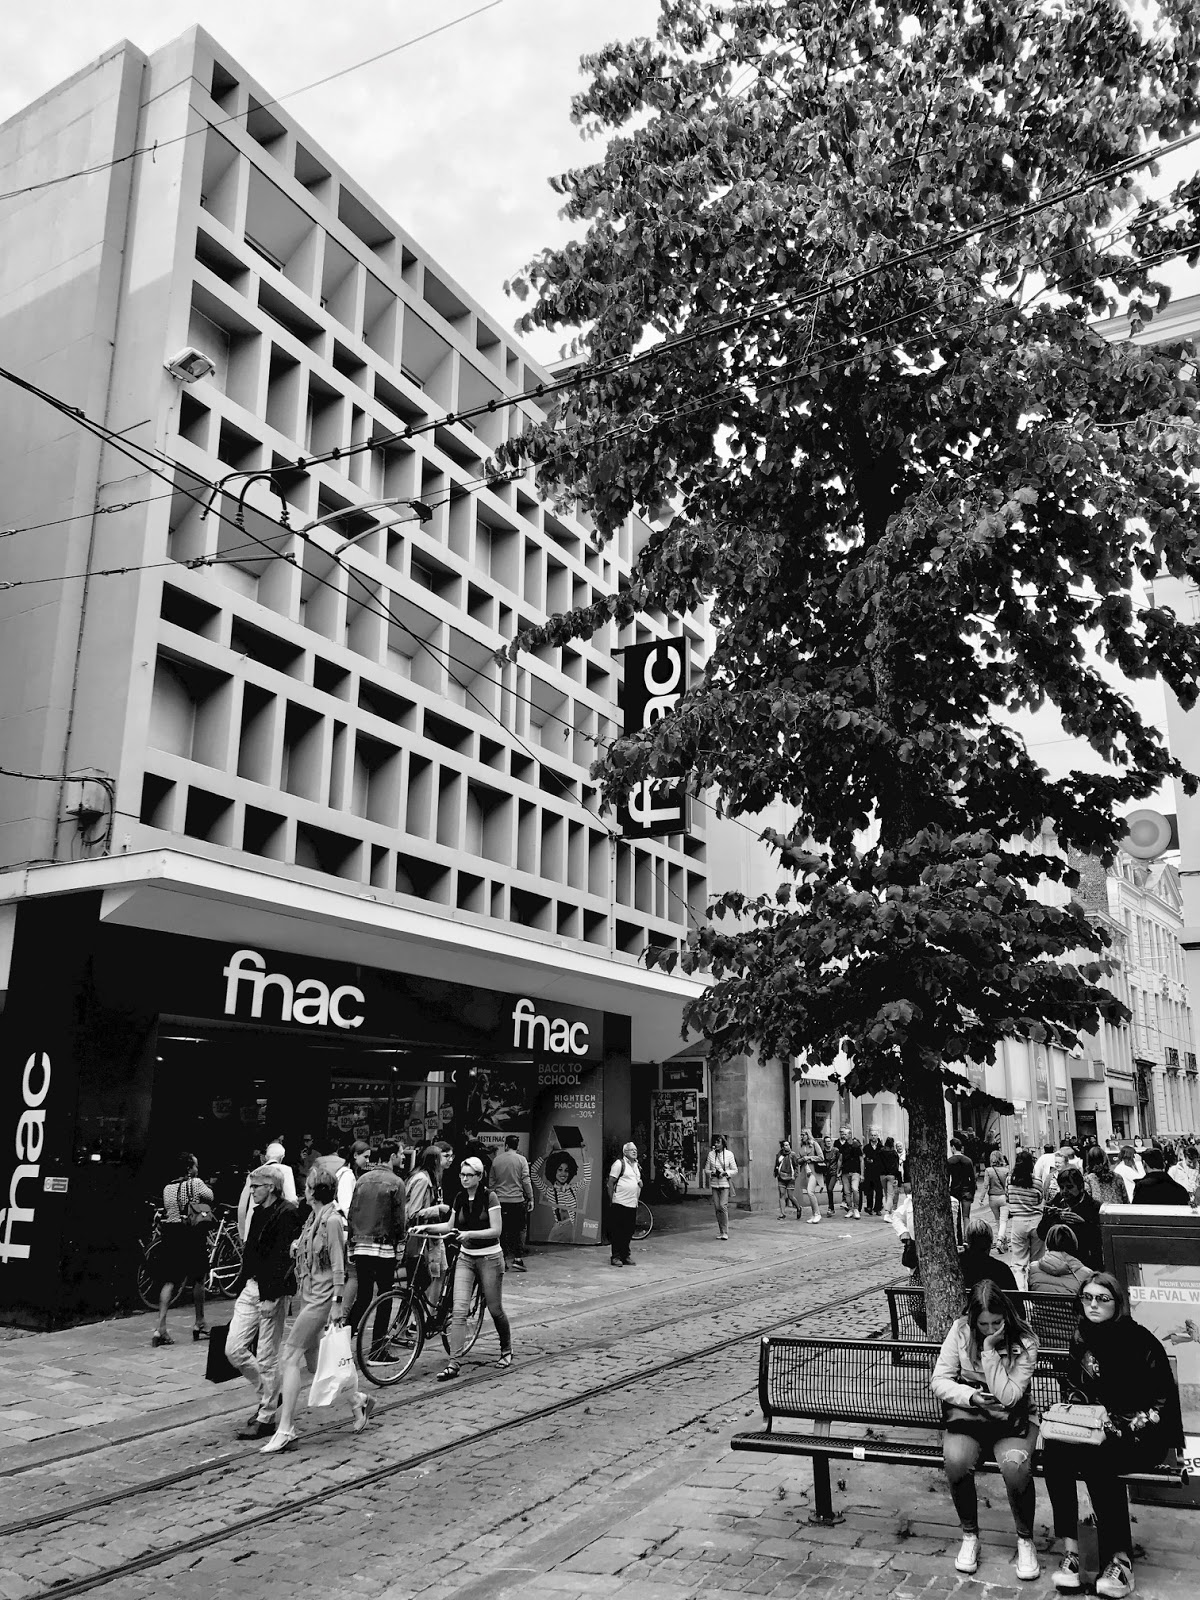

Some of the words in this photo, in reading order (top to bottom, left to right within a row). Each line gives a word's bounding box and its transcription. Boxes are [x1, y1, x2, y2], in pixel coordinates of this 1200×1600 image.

[223, 949, 365, 1029] fnac
[512, 998, 589, 1055] fnac
[538, 1063, 565, 1073] BACK
[568, 1063, 582, 1073] TO
[538, 1075, 581, 1085] SCHOOL
[0, 1052, 51, 1263] fnac
[1133, 1288, 1147, 1300] JE
[1150, 1289, 1187, 1302] AFVAL
